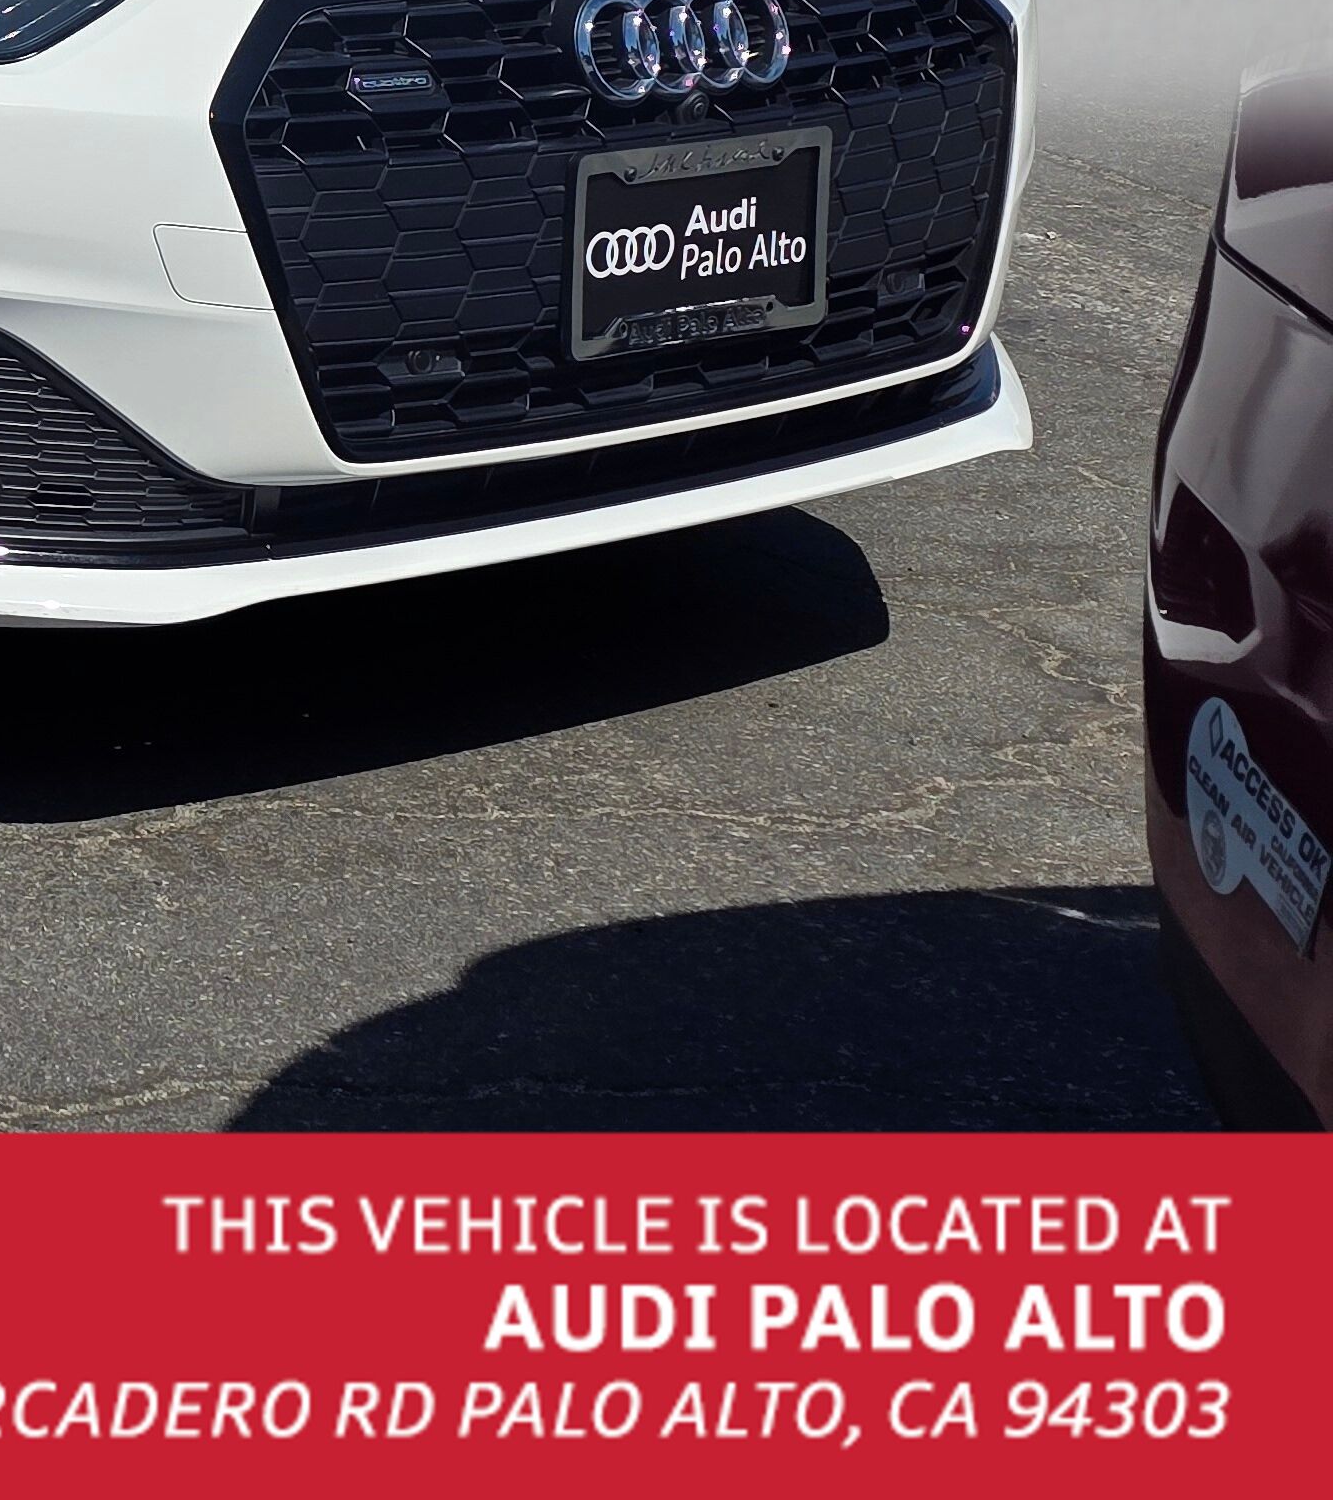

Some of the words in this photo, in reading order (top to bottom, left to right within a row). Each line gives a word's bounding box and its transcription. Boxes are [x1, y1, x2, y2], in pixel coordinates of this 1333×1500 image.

[684, 196, 757, 237] Audi
[680, 238, 742, 280] Palo
[748, 230, 807, 270] Alto
[629, 315, 673, 346] Audi
[677, 310, 718, 339] Palo
[1219, 739, 1295, 839] ACCESS
[1299, 832, 1328, 881] OK
[1189, 755, 1230, 817] CLEAN
[1231, 814, 1257, 851] AIR
[1259, 843, 1315, 926] VEHICLE
